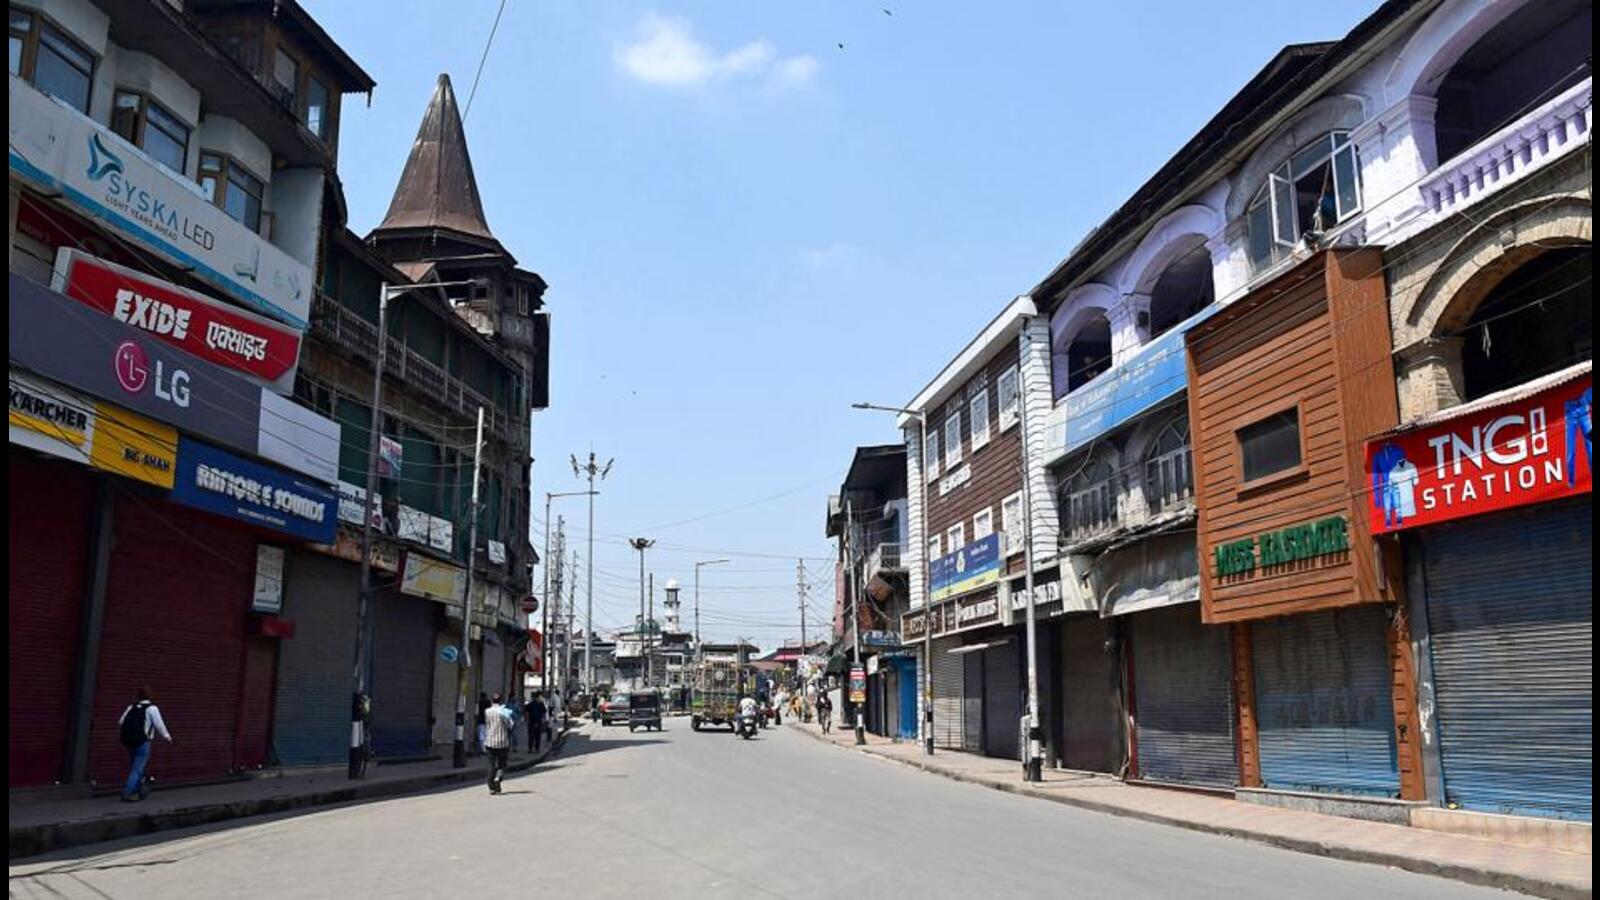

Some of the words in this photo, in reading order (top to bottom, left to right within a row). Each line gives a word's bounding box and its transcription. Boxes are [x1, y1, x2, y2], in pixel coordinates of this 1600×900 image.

[107, 173, 178, 231] SYSKA
[183, 217, 215, 251] LED
[113, 289, 192, 340] EXIDE
[155, 360, 191, 408] LG
[272, 489, 325, 523] SOUNDS
[1422, 457, 1563, 509] STATION
[1214, 538, 1255, 577] MISS
[1259, 516, 1350, 567] KASHMIR
